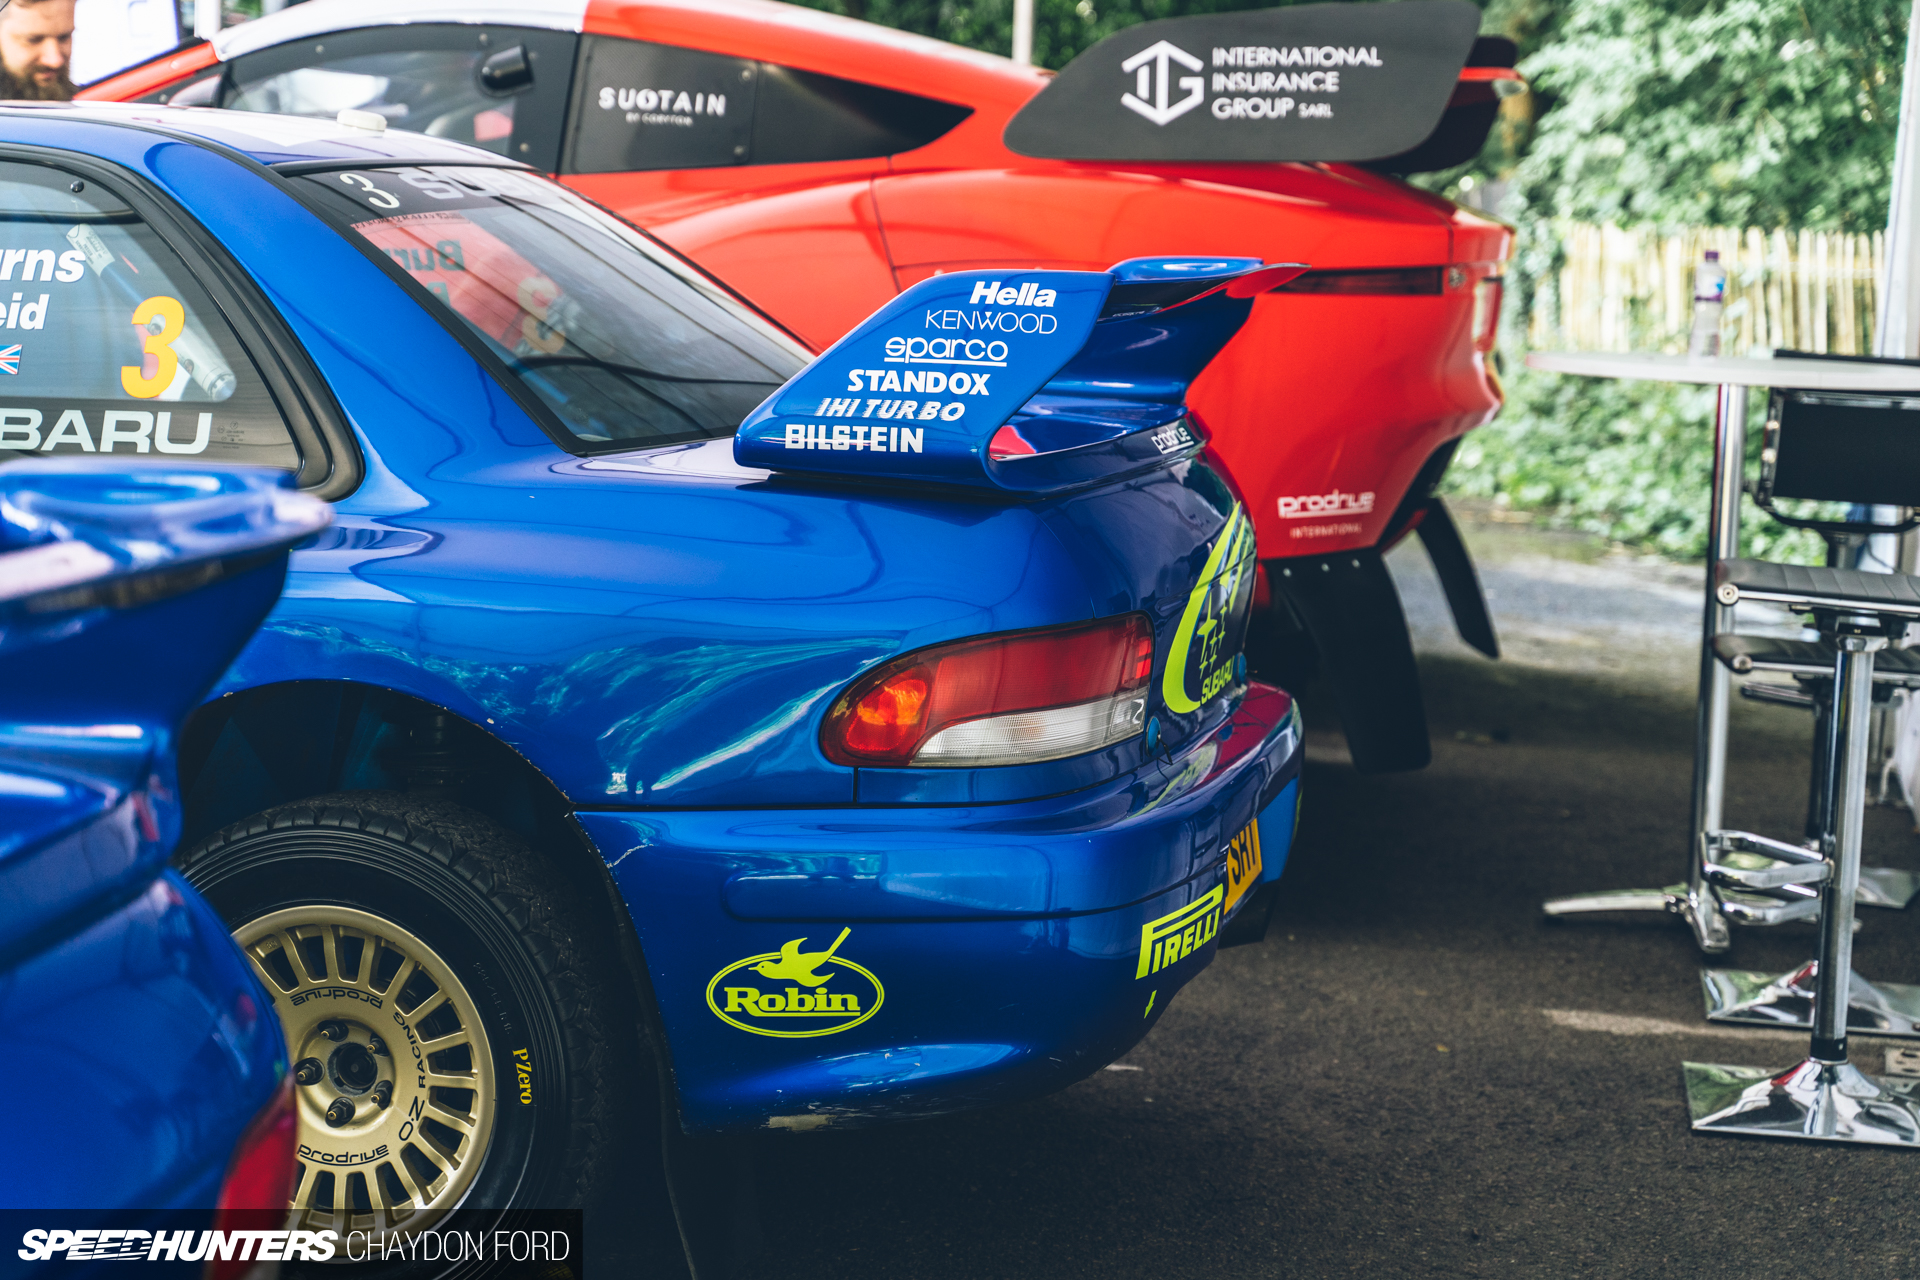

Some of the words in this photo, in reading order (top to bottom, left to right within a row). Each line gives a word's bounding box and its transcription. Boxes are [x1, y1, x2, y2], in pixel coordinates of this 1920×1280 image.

[1212, 46, 1383, 67] INTERNATIONAL
[1212, 71, 1340, 92] INSURANCE
[1211, 97, 1295, 120] GROUP
[339, 173, 400, 208] 3
[0, 249, 86, 283] rns
[969, 281, 1057, 308] Hella
[925, 309, 1058, 334] KENWOOD
[121, 296, 185, 398] 3
[884, 336, 1009, 367] sparco
[847, 369, 991, 396] STANDOX
[814, 398, 861, 418] IHI
[862, 399, 966, 421] TURBO
[784, 424, 924, 453] BILSTEIN
[1277, 488, 1376, 519] prodrive
[1201, 655, 1235, 705] SUBARU
[1135, 883, 1224, 981] PIRELLI
[724, 987, 861, 1017] Robin
[393, 1011, 427, 1089] RACING
[296, 1144, 390, 1167] prodrive
